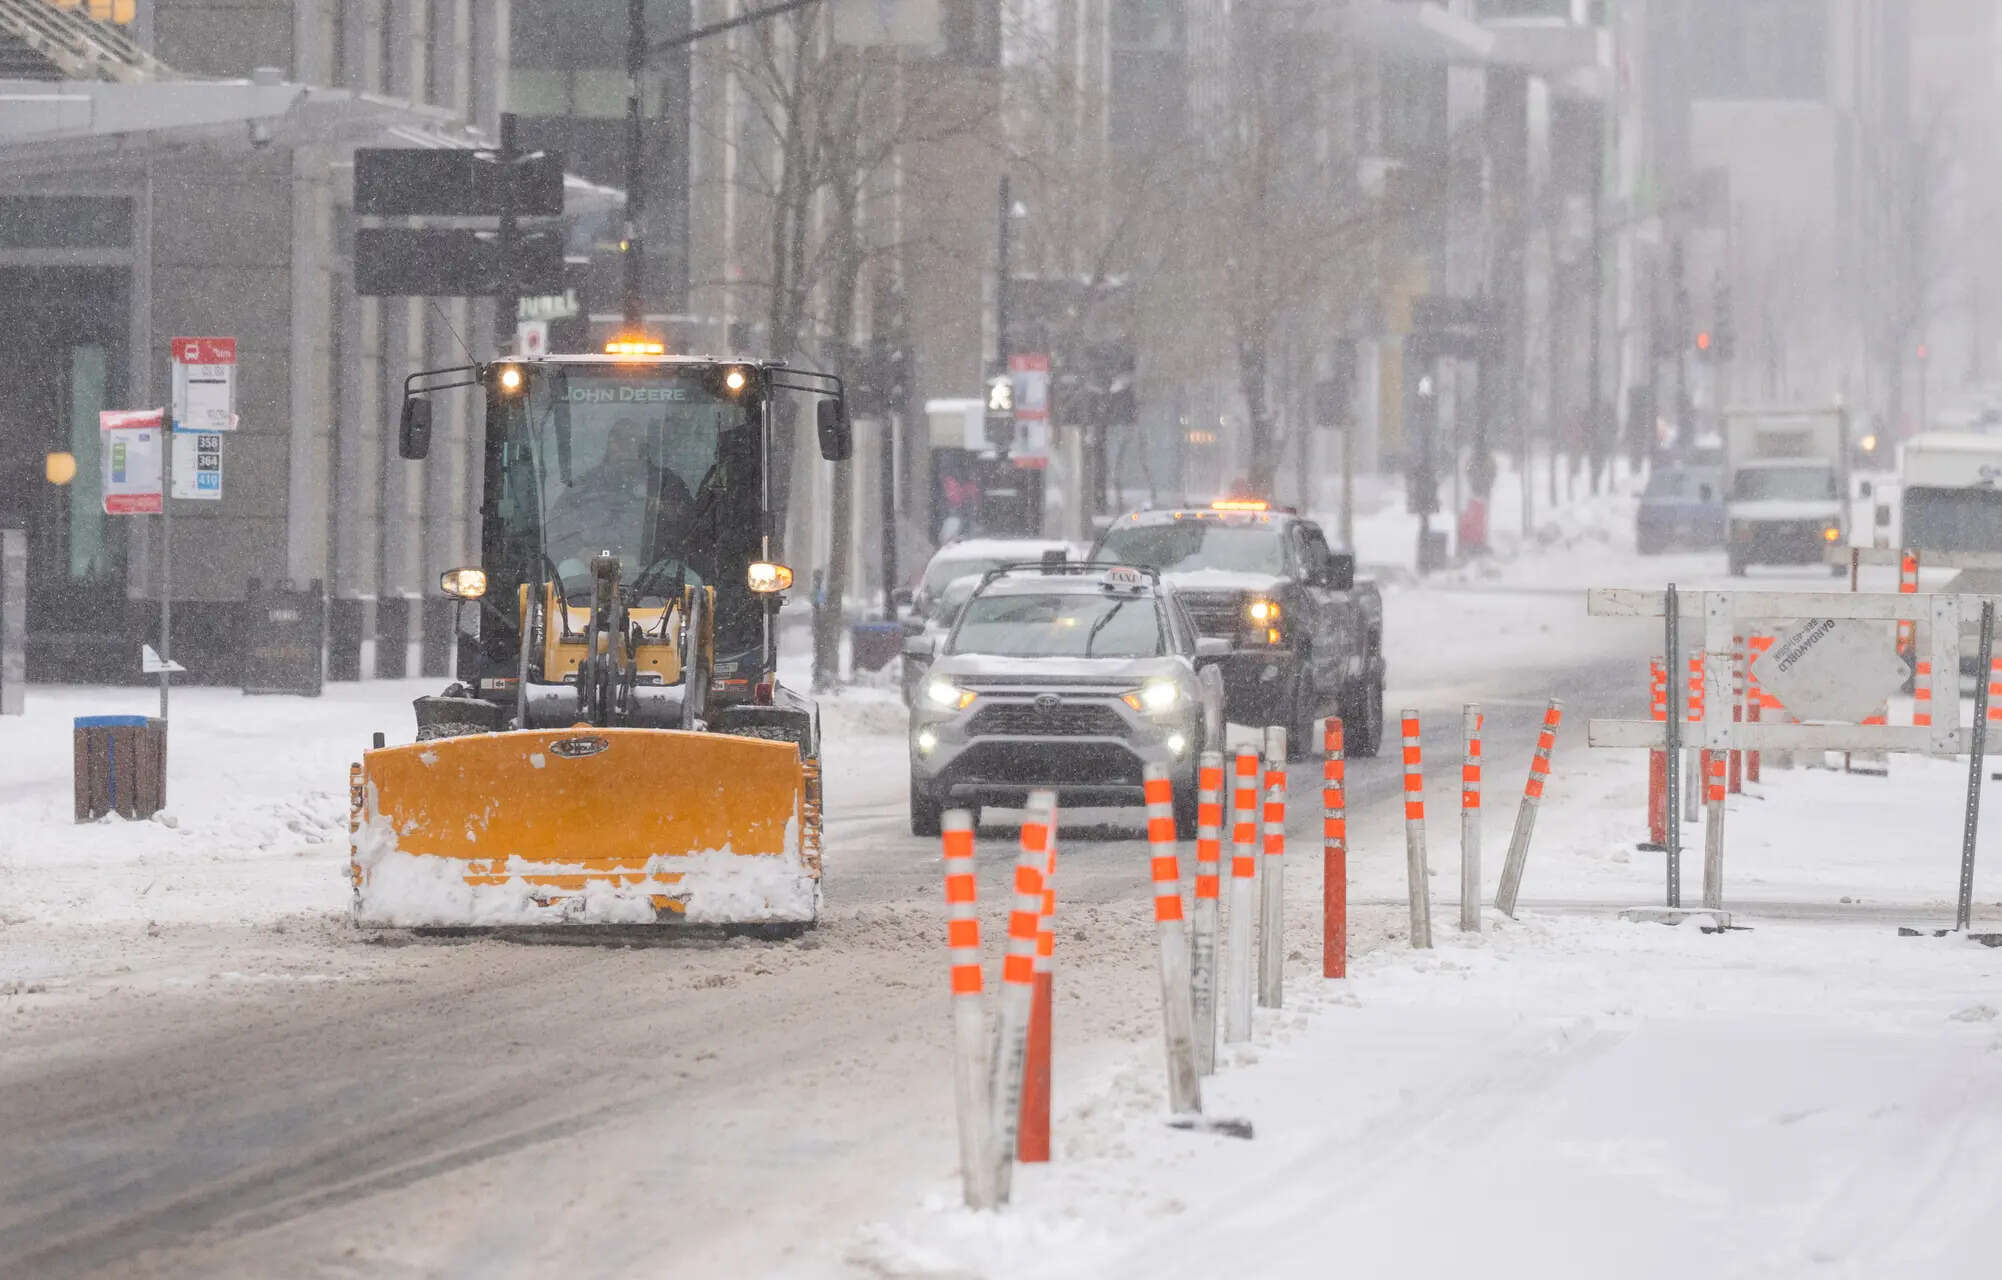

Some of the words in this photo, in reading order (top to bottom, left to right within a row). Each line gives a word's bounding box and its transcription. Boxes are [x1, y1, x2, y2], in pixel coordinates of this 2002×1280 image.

[619, 386, 686, 401] DEERE
[199, 437, 218, 448] 358
[199, 455, 218, 466] 364
[1111, 571, 1142, 584] TAXI
[1778, 619, 1836, 673] GARDAWORLD
